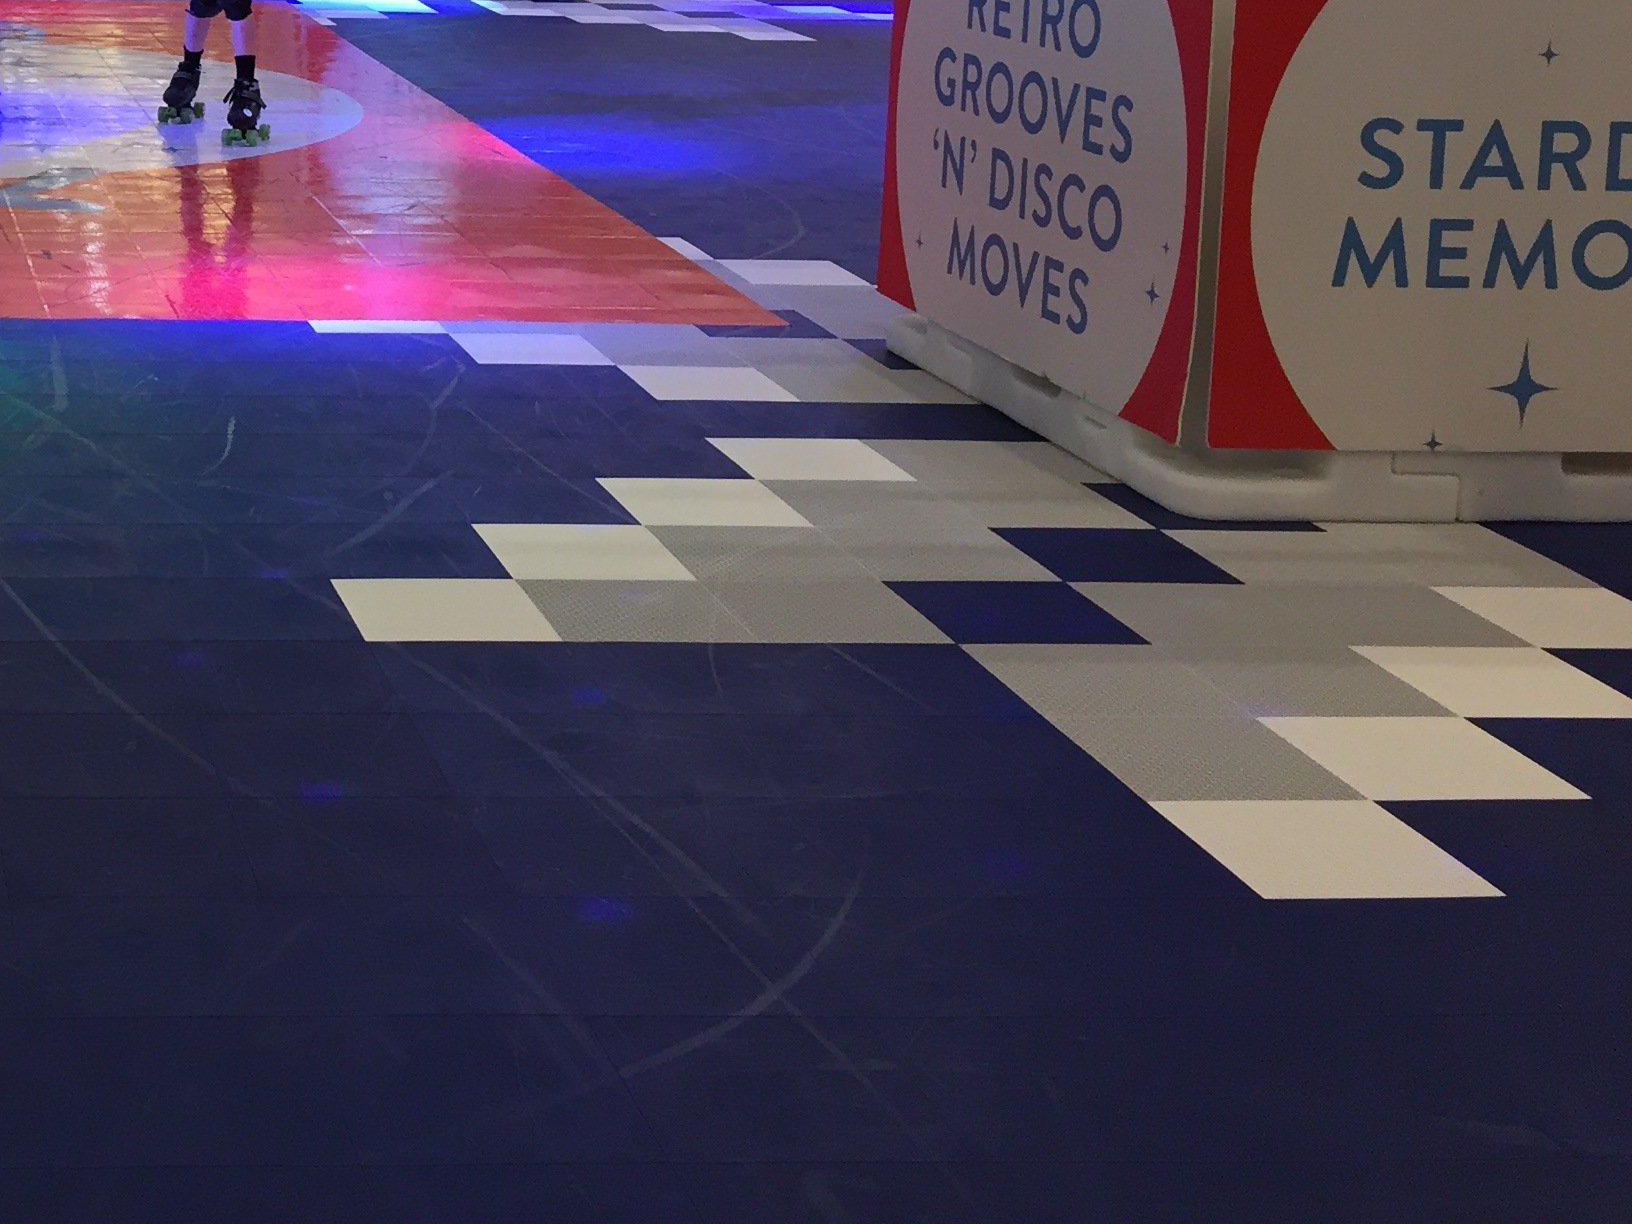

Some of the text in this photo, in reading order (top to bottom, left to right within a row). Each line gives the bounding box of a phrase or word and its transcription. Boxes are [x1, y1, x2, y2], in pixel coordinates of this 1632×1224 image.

[933, 46, 1135, 164] GROOVES
[932, 127, 1123, 253] 'N' DISCO
[946, 217, 1090, 336] MOVES
[1331, 216, 1632, 292] MEMO
